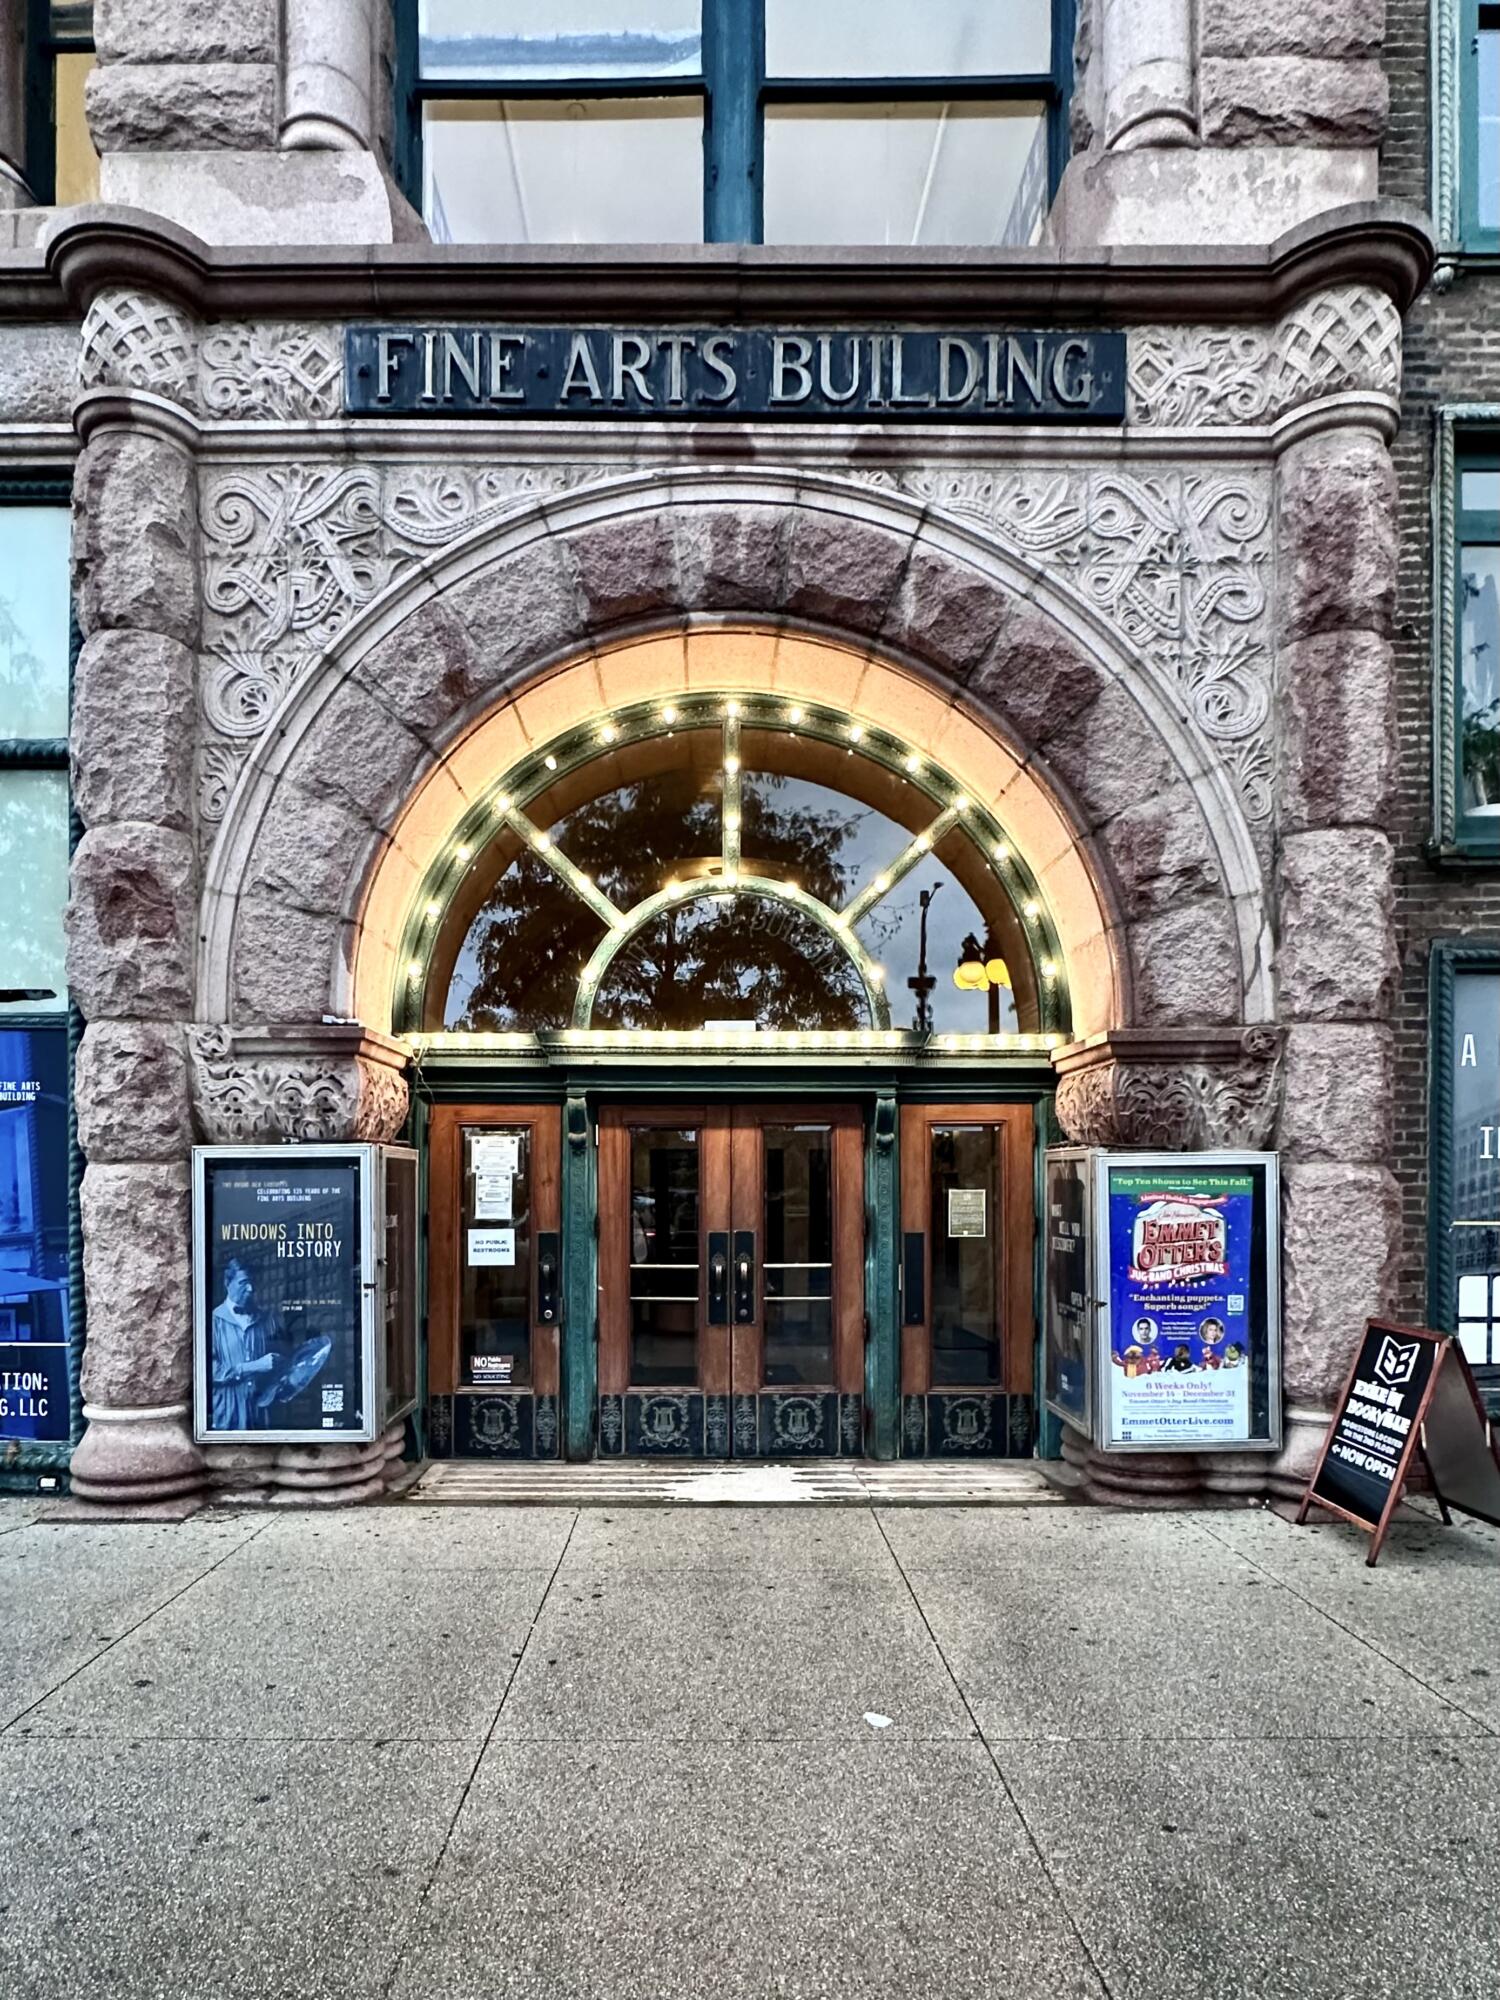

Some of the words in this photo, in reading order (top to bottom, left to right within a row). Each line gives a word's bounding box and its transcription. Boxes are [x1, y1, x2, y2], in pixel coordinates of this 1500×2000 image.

[376, 332, 525, 400] FINE
[560, 333, 738, 401] ARTS
[770, 334, 1094, 403] BUILDING
[1461, 1033, 1477, 1067] A
[21, 1081, 41, 1091] ARTS
[257, 1187, 291, 1195] CELEBRATING
[221, 1223, 287, 1241] WINDOWS
[297, 1223, 333, 1240] INTO
[1143, 1219, 1219, 1244] EMMET
[277, 1240, 342, 1258] HISTORY
[1137, 1241, 1222, 1271] OTTER'S
[1173, 1262, 1225, 1278] CHRISTMAS
[1143, 1302, 1177, 1311] Superb
[473, 1356, 488, 1368] NO
[1154, 1382, 1184, 1390] Weeks
[1186, 1381, 1212, 1391] Only!
[1121, 1417, 1234, 1426] EmmetOtterLive.com
[1341, 1418, 1377, 1438] BOOKSTORE
[1376, 1430, 1404, 1449] LOCATED
[1375, 1440, 1396, 1456] FLOOR
[1339, 1445, 1367, 1468] NOW
[1364, 1456, 1397, 1481] OPEN
